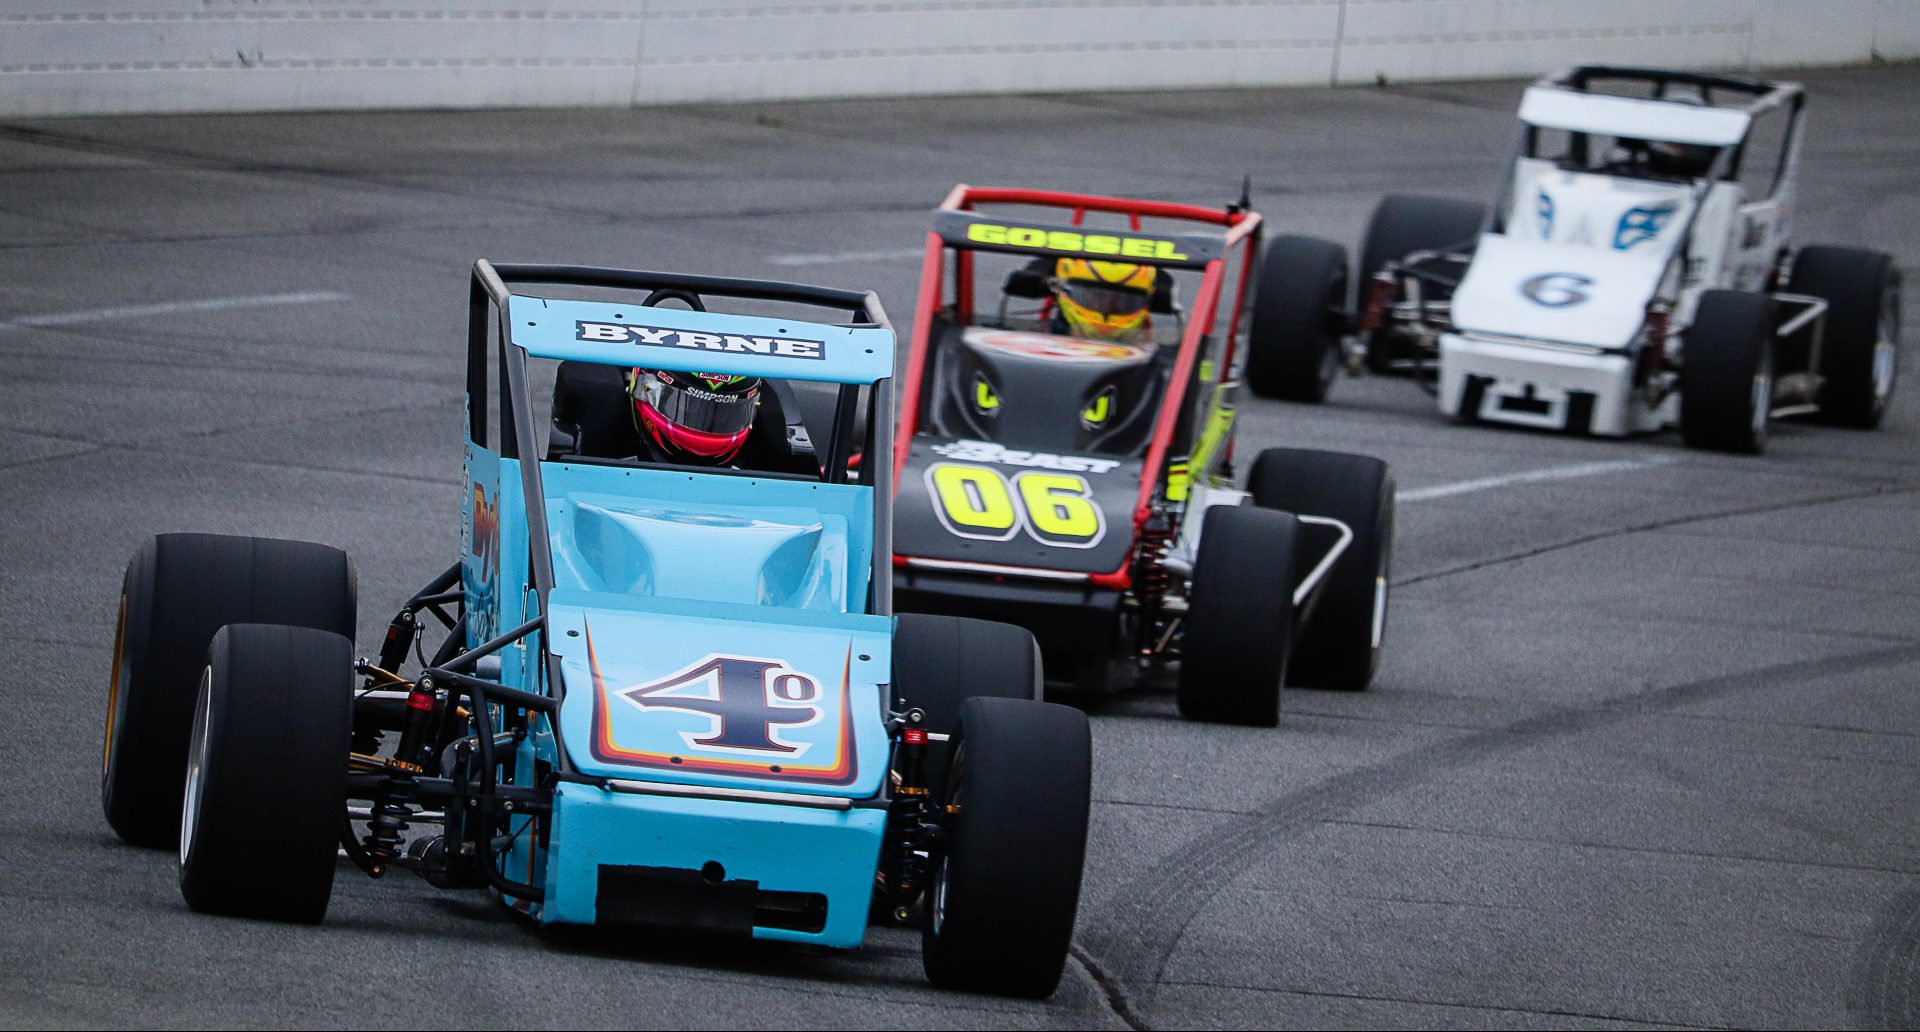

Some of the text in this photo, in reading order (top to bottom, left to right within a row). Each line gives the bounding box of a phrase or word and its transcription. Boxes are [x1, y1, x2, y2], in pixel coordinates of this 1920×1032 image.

[967, 223, 1189, 261] GOSSEL
[1519, 271, 1594, 309] 6
[581, 323, 820, 358] BYRNE
[686, 386, 738, 403] SIMPSON
[940, 439, 1121, 474] BEAST
[925, 463, 1105, 547] 06
